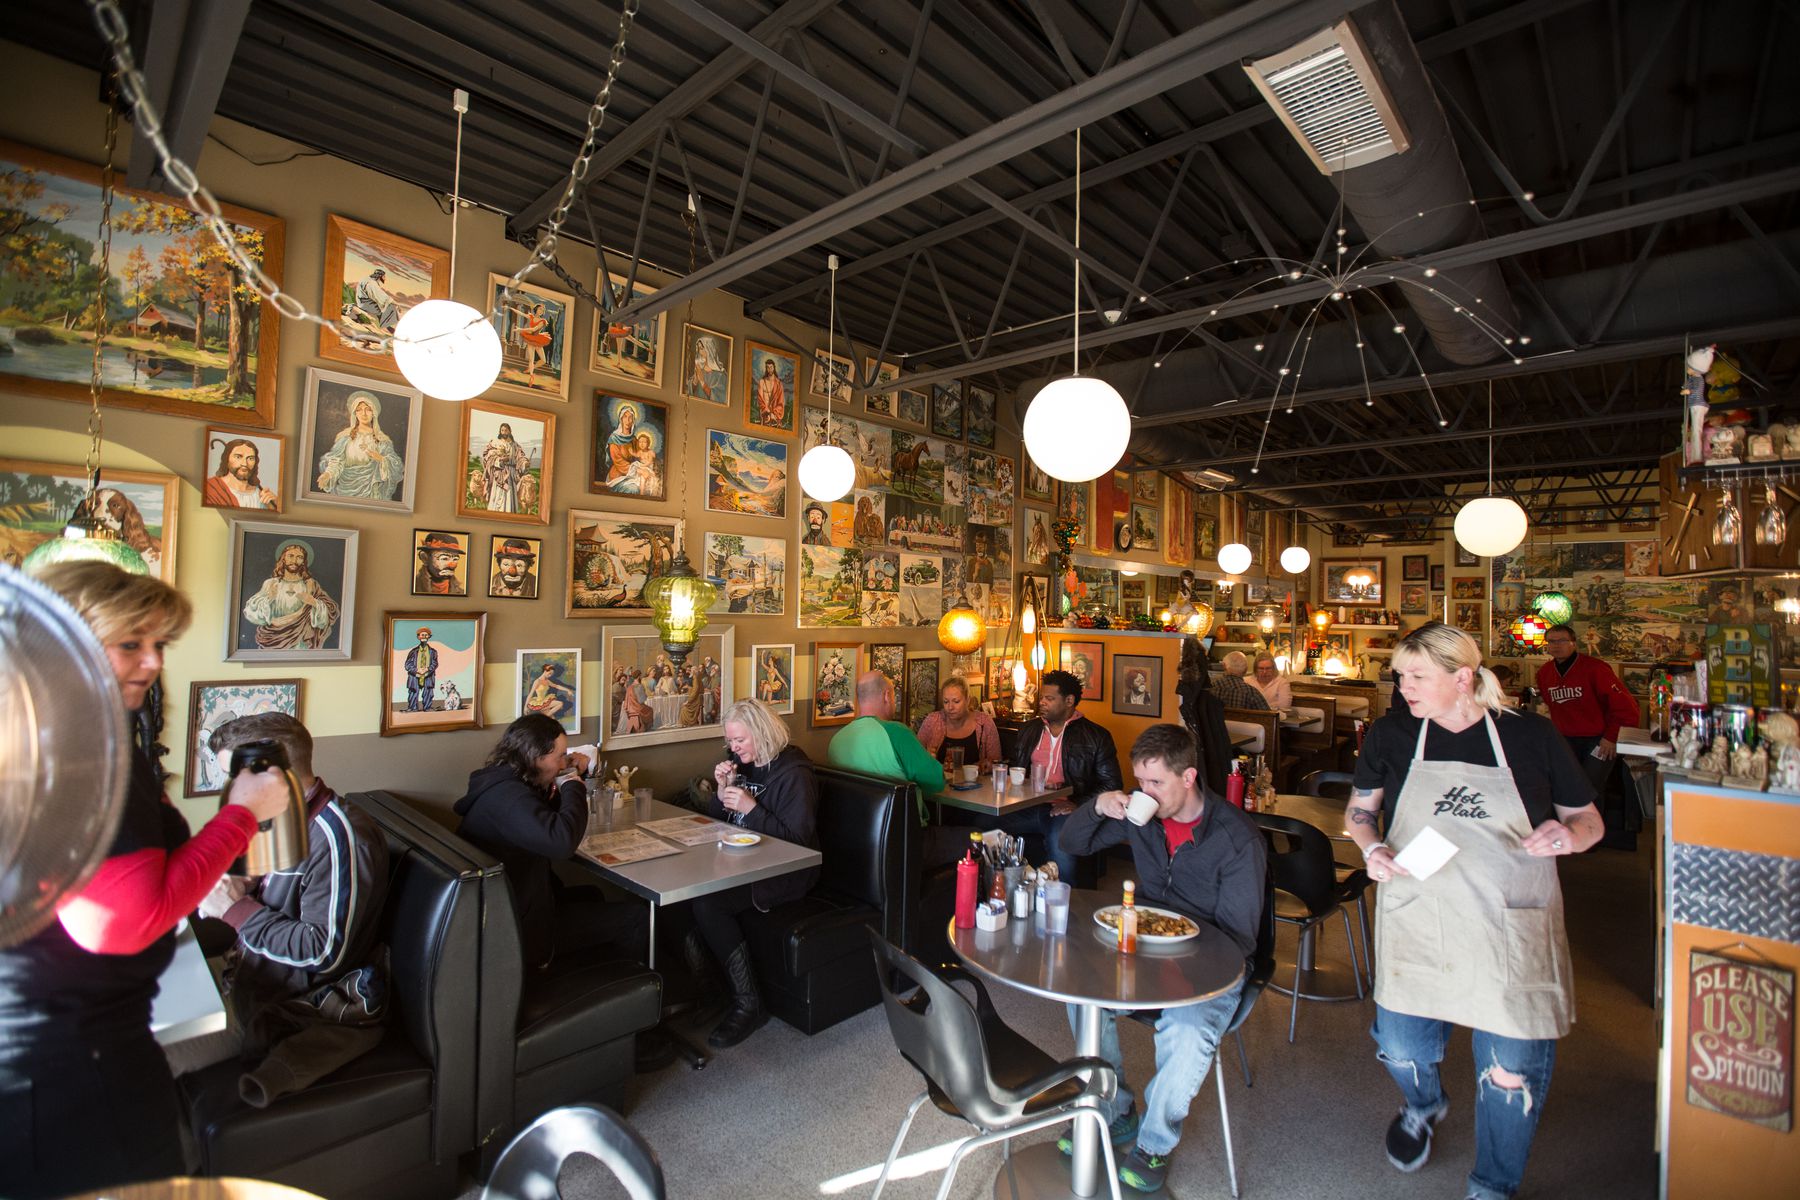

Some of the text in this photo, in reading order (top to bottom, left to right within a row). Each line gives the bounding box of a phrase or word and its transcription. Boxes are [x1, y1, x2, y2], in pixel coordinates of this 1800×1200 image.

[1547, 685, 1583, 703] Twins
[1433, 800, 1492, 819] Plate
[1443, 785, 1485, 804] Hot
[1694, 966, 1789, 1020] PLEASE
[1702, 992, 1779, 1049] USE
[1691, 1030, 1785, 1099] SPITOON
